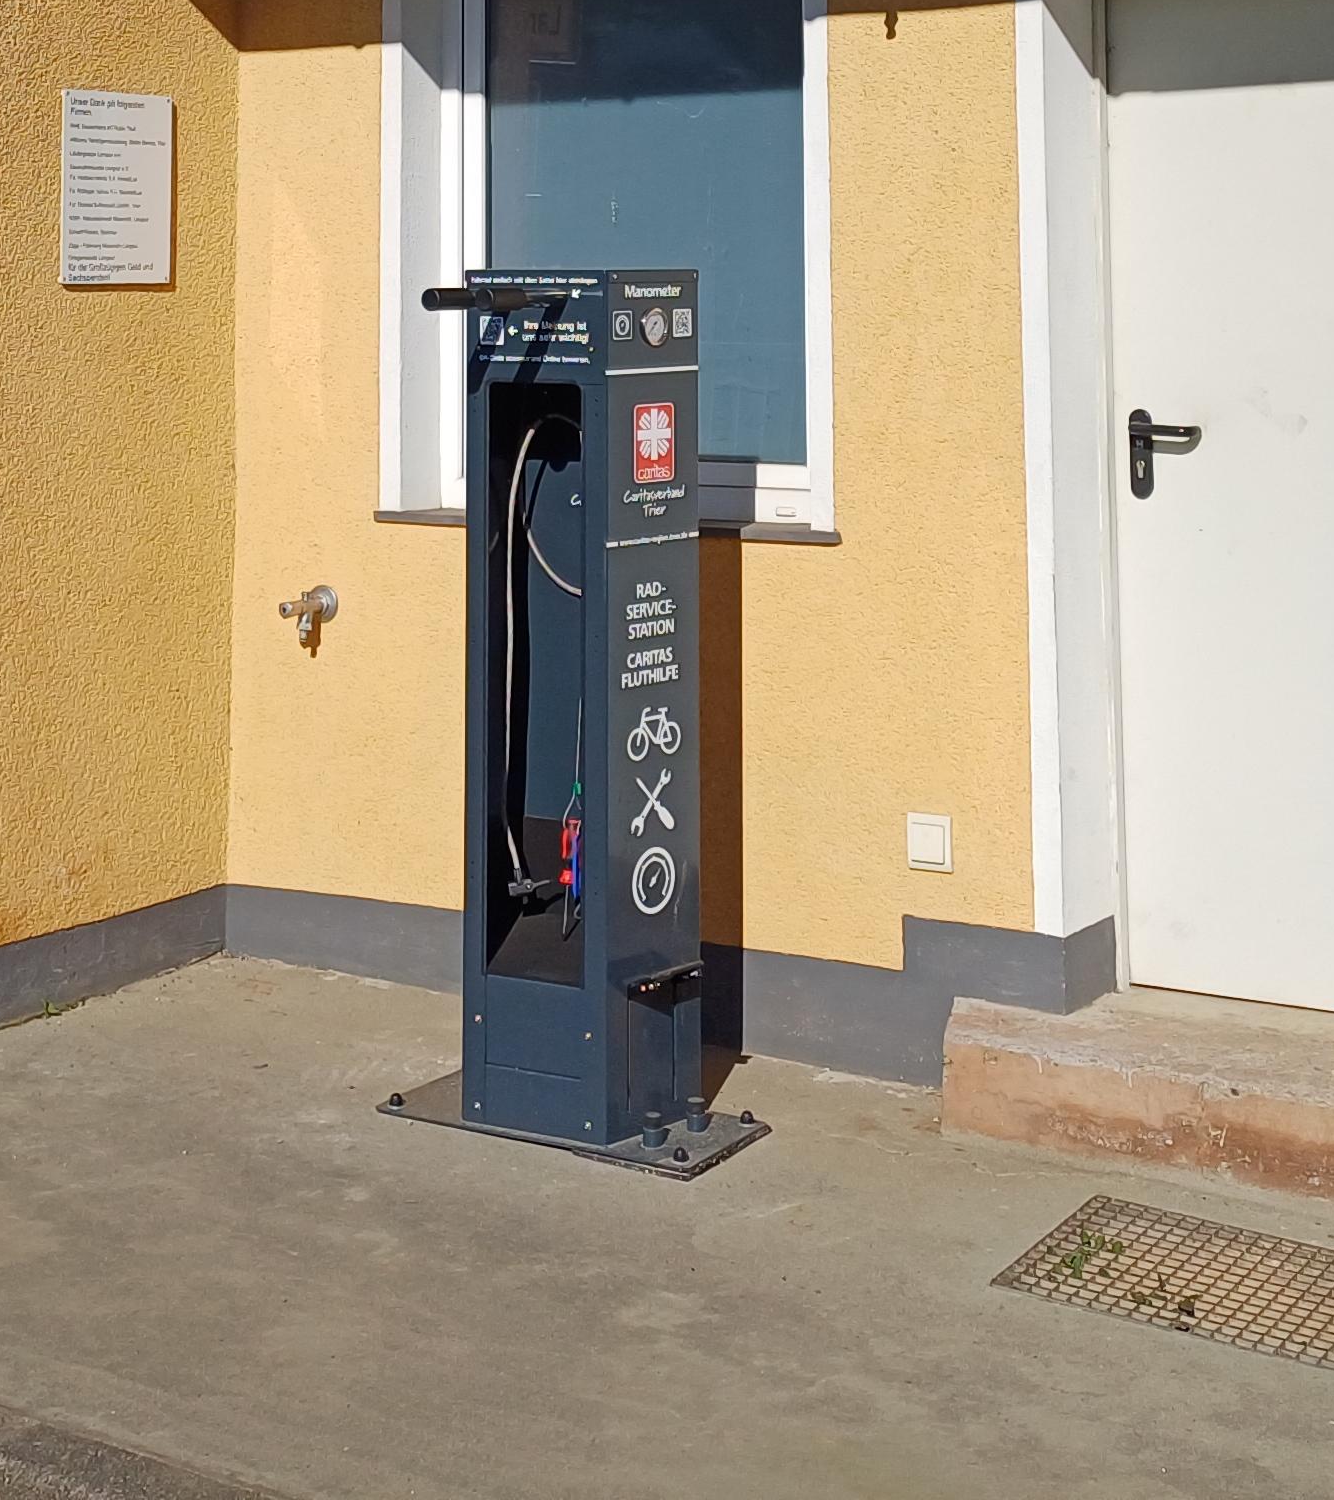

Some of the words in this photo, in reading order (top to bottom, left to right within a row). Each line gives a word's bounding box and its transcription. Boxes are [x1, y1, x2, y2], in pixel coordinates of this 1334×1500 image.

[624, 284, 682, 299] Manometer
[637, 462, 671, 480] caritas
[642, 503, 667, 518] Trier
[636, 581, 667, 599] RAD-
[626, 599, 677, 621] SERVICE-
[627, 618, 675, 640] STATION
[626, 647, 673, 669] CARITAS
[620, 664, 680, 690] FLUTHILFE
